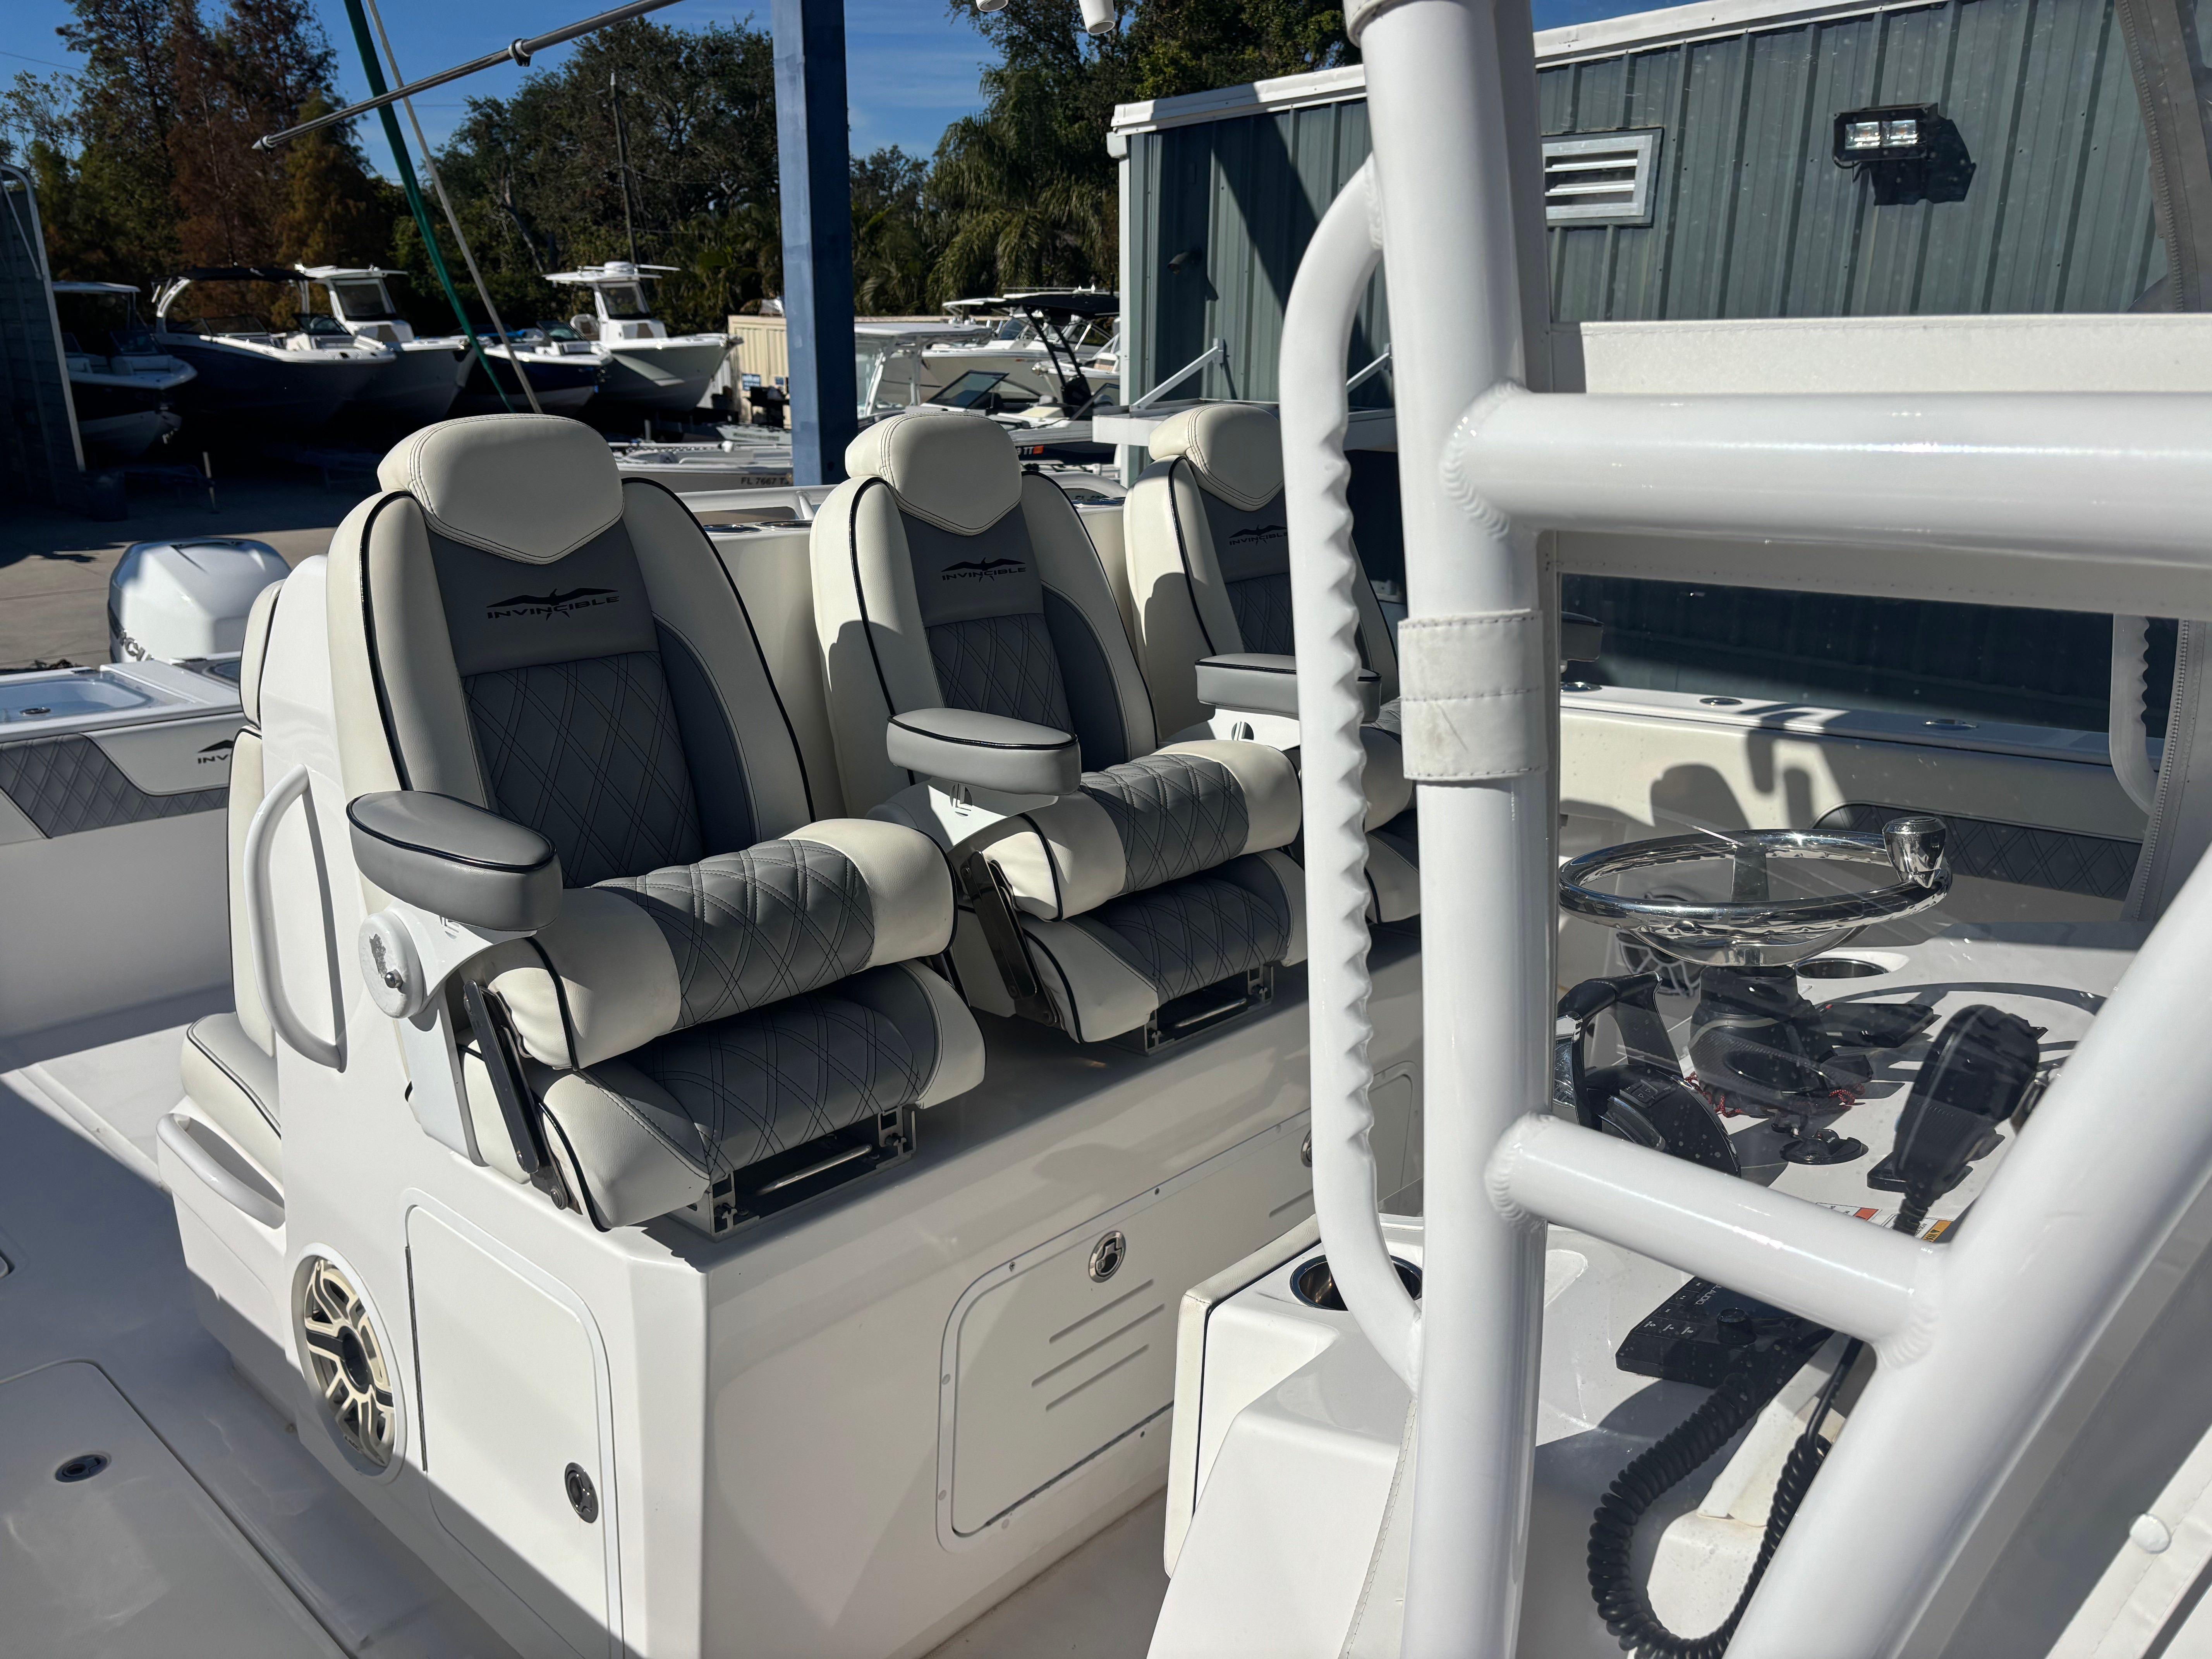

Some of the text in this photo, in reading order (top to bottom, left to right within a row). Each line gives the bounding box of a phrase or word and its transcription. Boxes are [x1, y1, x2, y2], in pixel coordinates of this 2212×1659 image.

[740, 477, 753, 485] FL
[941, 567, 1026, 581] INVINCIBLE
[487, 595, 620, 619] INVINCIBLE
